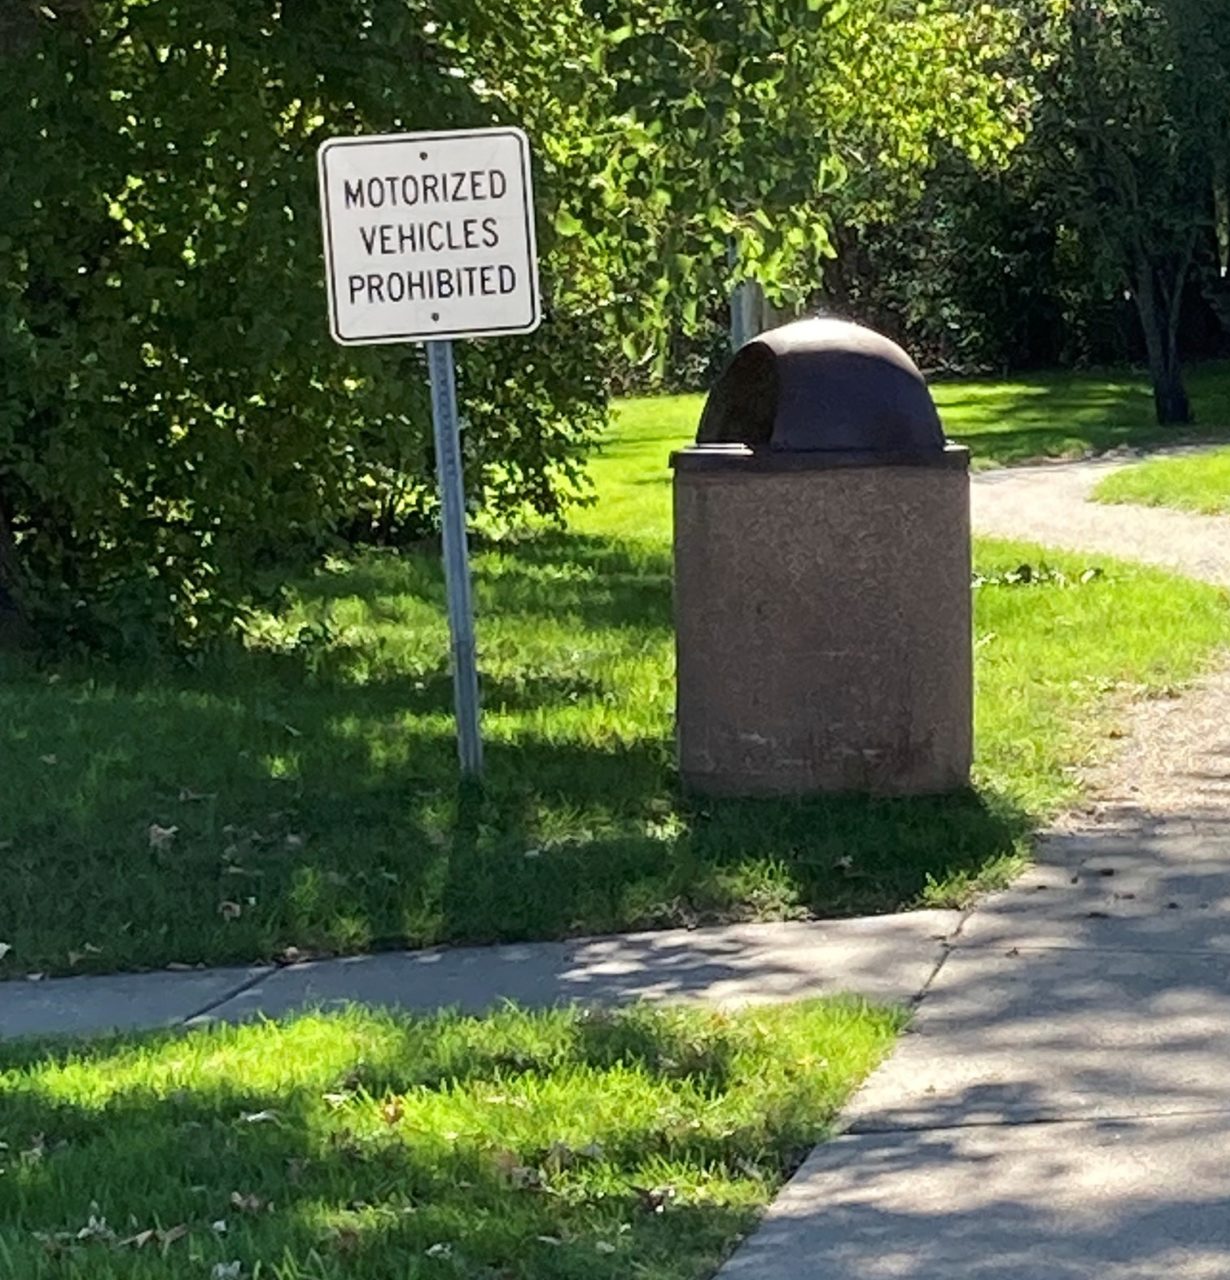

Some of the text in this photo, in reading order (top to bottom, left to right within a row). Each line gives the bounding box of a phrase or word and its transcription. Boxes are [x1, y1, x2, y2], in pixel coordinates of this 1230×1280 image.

[344, 170, 506, 209] MOTORIZED
[359, 217, 499, 256] VEHICLES
[348, 264, 516, 305] PROHIBITED
